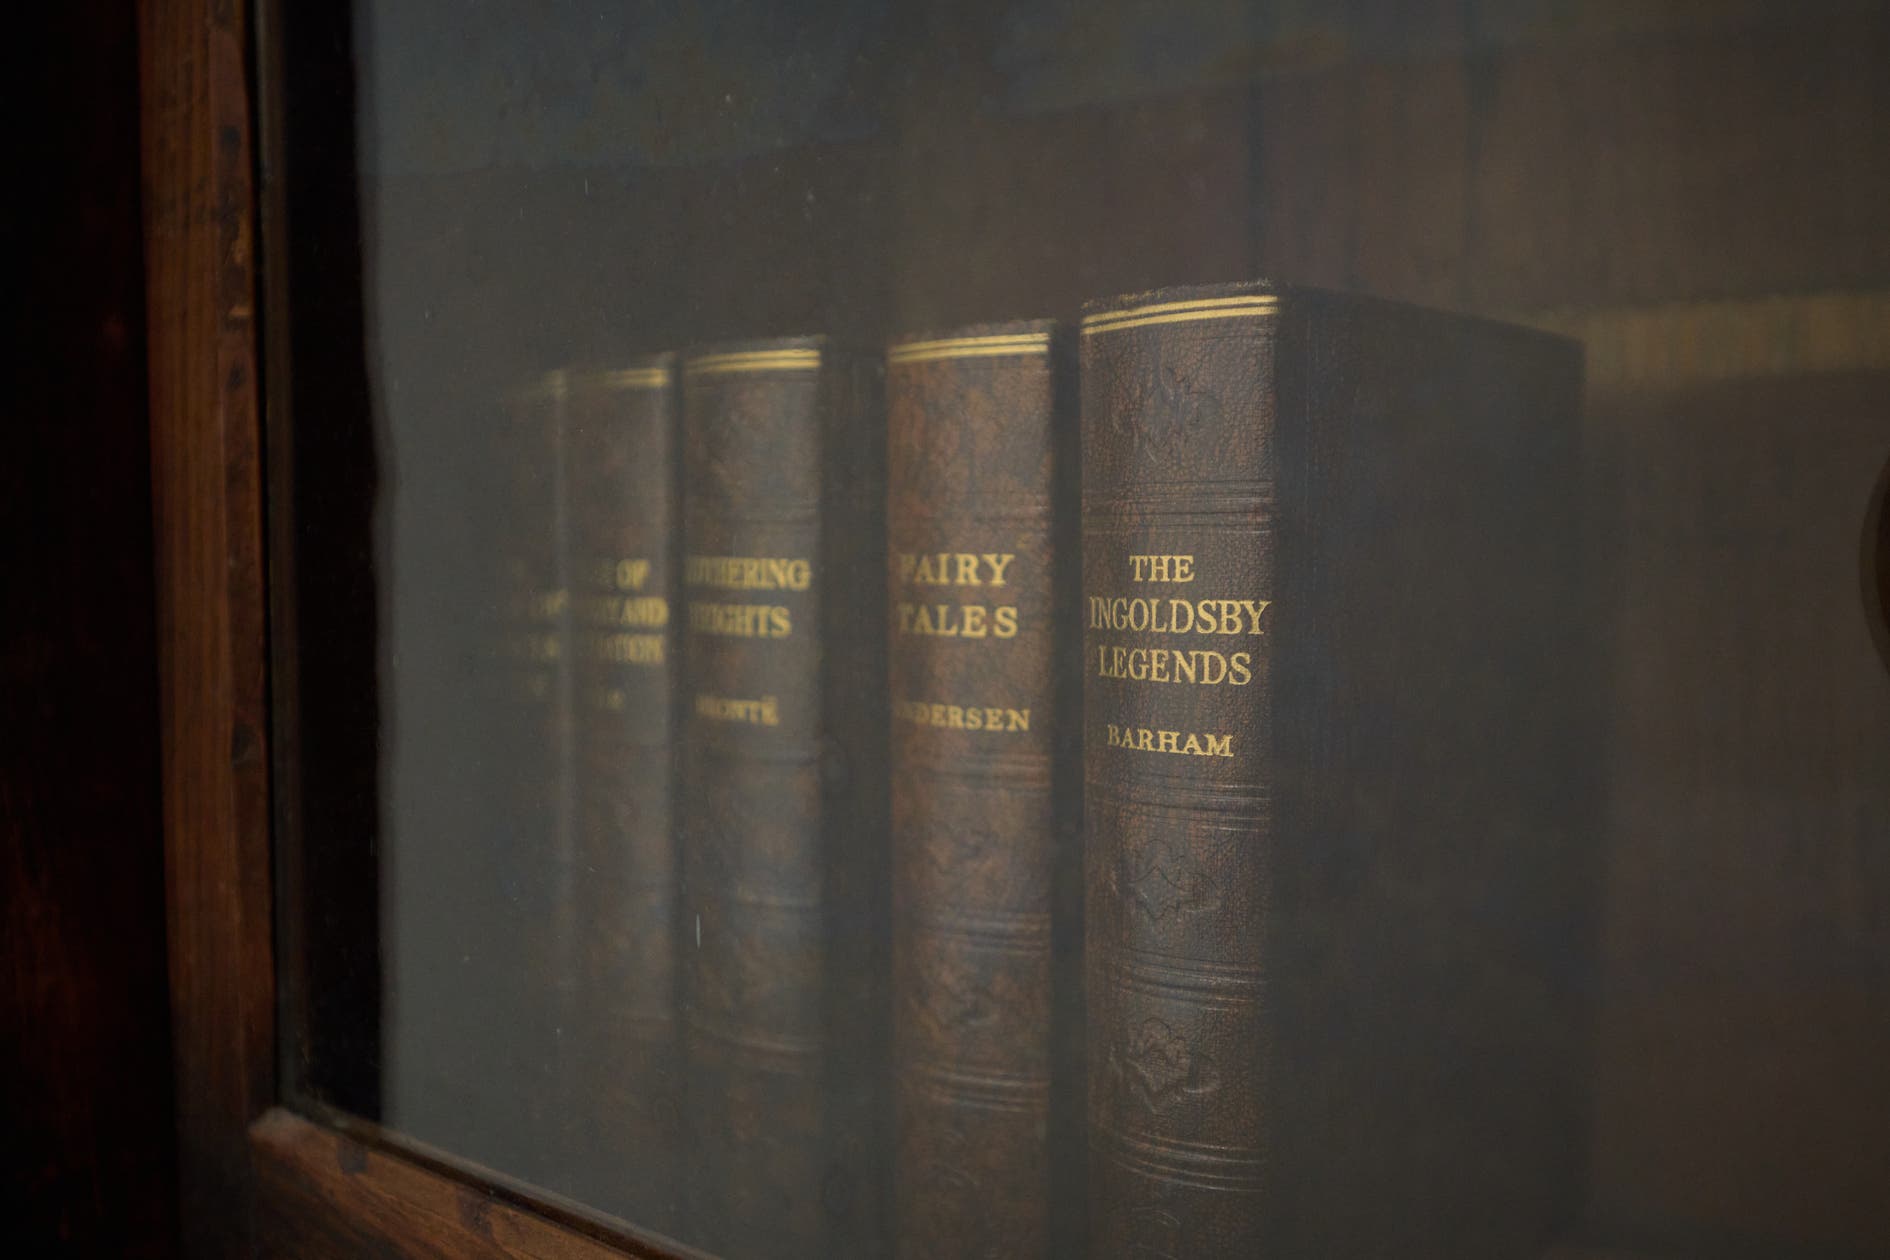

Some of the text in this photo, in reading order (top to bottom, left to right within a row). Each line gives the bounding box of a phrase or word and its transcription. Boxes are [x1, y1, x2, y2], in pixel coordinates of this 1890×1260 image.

[899, 552, 1015, 587] FAIRY
[1129, 555, 1195, 583] THE
[897, 602, 1018, 640] TALES
[1089, 596, 1272, 635] INGOLDSBY
[1098, 645, 1252, 686] LEGENDS
[895, 700, 1031, 732] DERSEN
[1107, 723, 1234, 757] BARHAM
